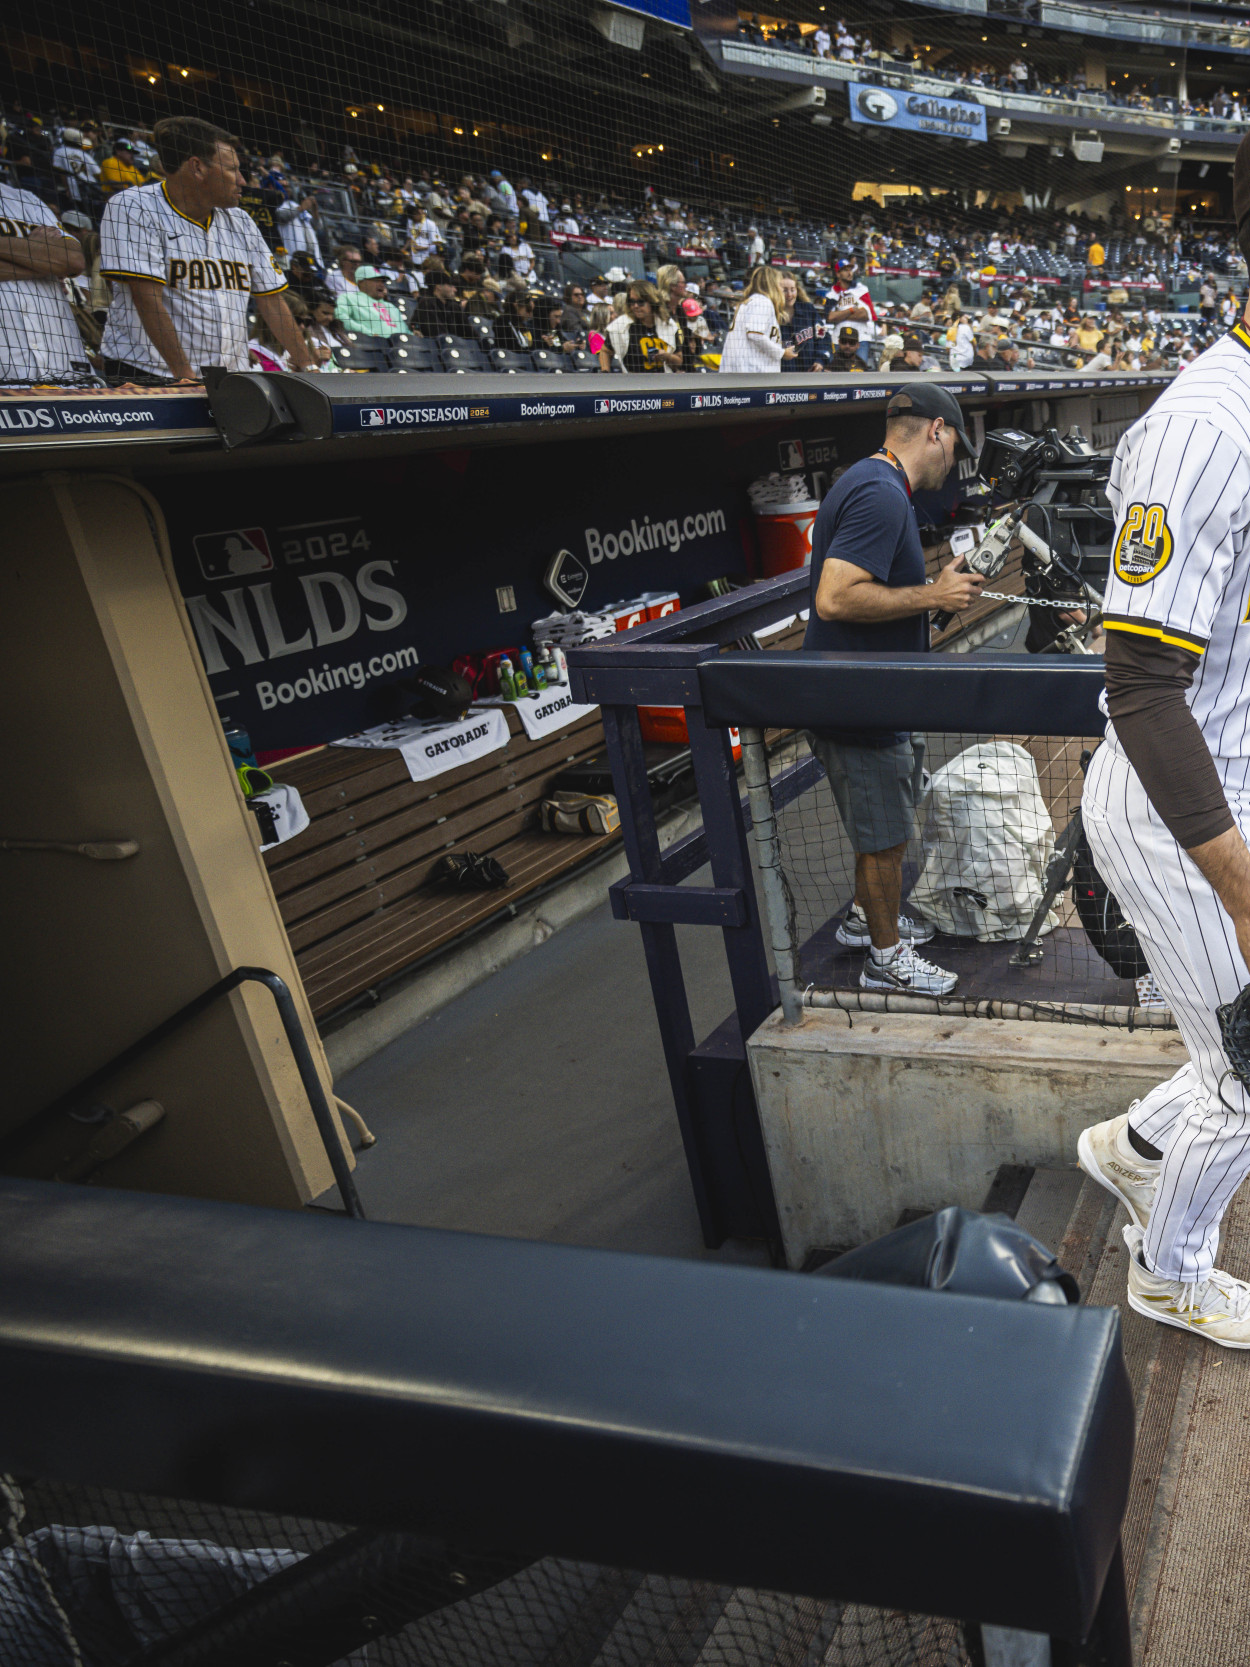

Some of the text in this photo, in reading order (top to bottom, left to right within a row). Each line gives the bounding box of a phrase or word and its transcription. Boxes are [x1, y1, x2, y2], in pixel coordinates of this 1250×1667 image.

[905, 96, 983, 126] Gallagher
[520, 403, 575, 417] Booking.com
[610, 399, 661, 412] POSTSEASON
[703, 395, 751, 407] NLDS Booking.com
[775, 393, 809, 403] POSTSEASON
[61, 410, 154, 425] Booking.com
[386, 407, 490, 425] POSTSEASON 2024
[585, 509, 726, 565] Booking.com
[1125, 504, 1165, 548] 20
[282, 529, 371, 565] 2024
[185, 559, 408, 675] NLDS
[256, 646, 419, 711] Booking.com
[535, 695, 573, 720] GATORA
[425, 723, 490, 758] GATORADE
